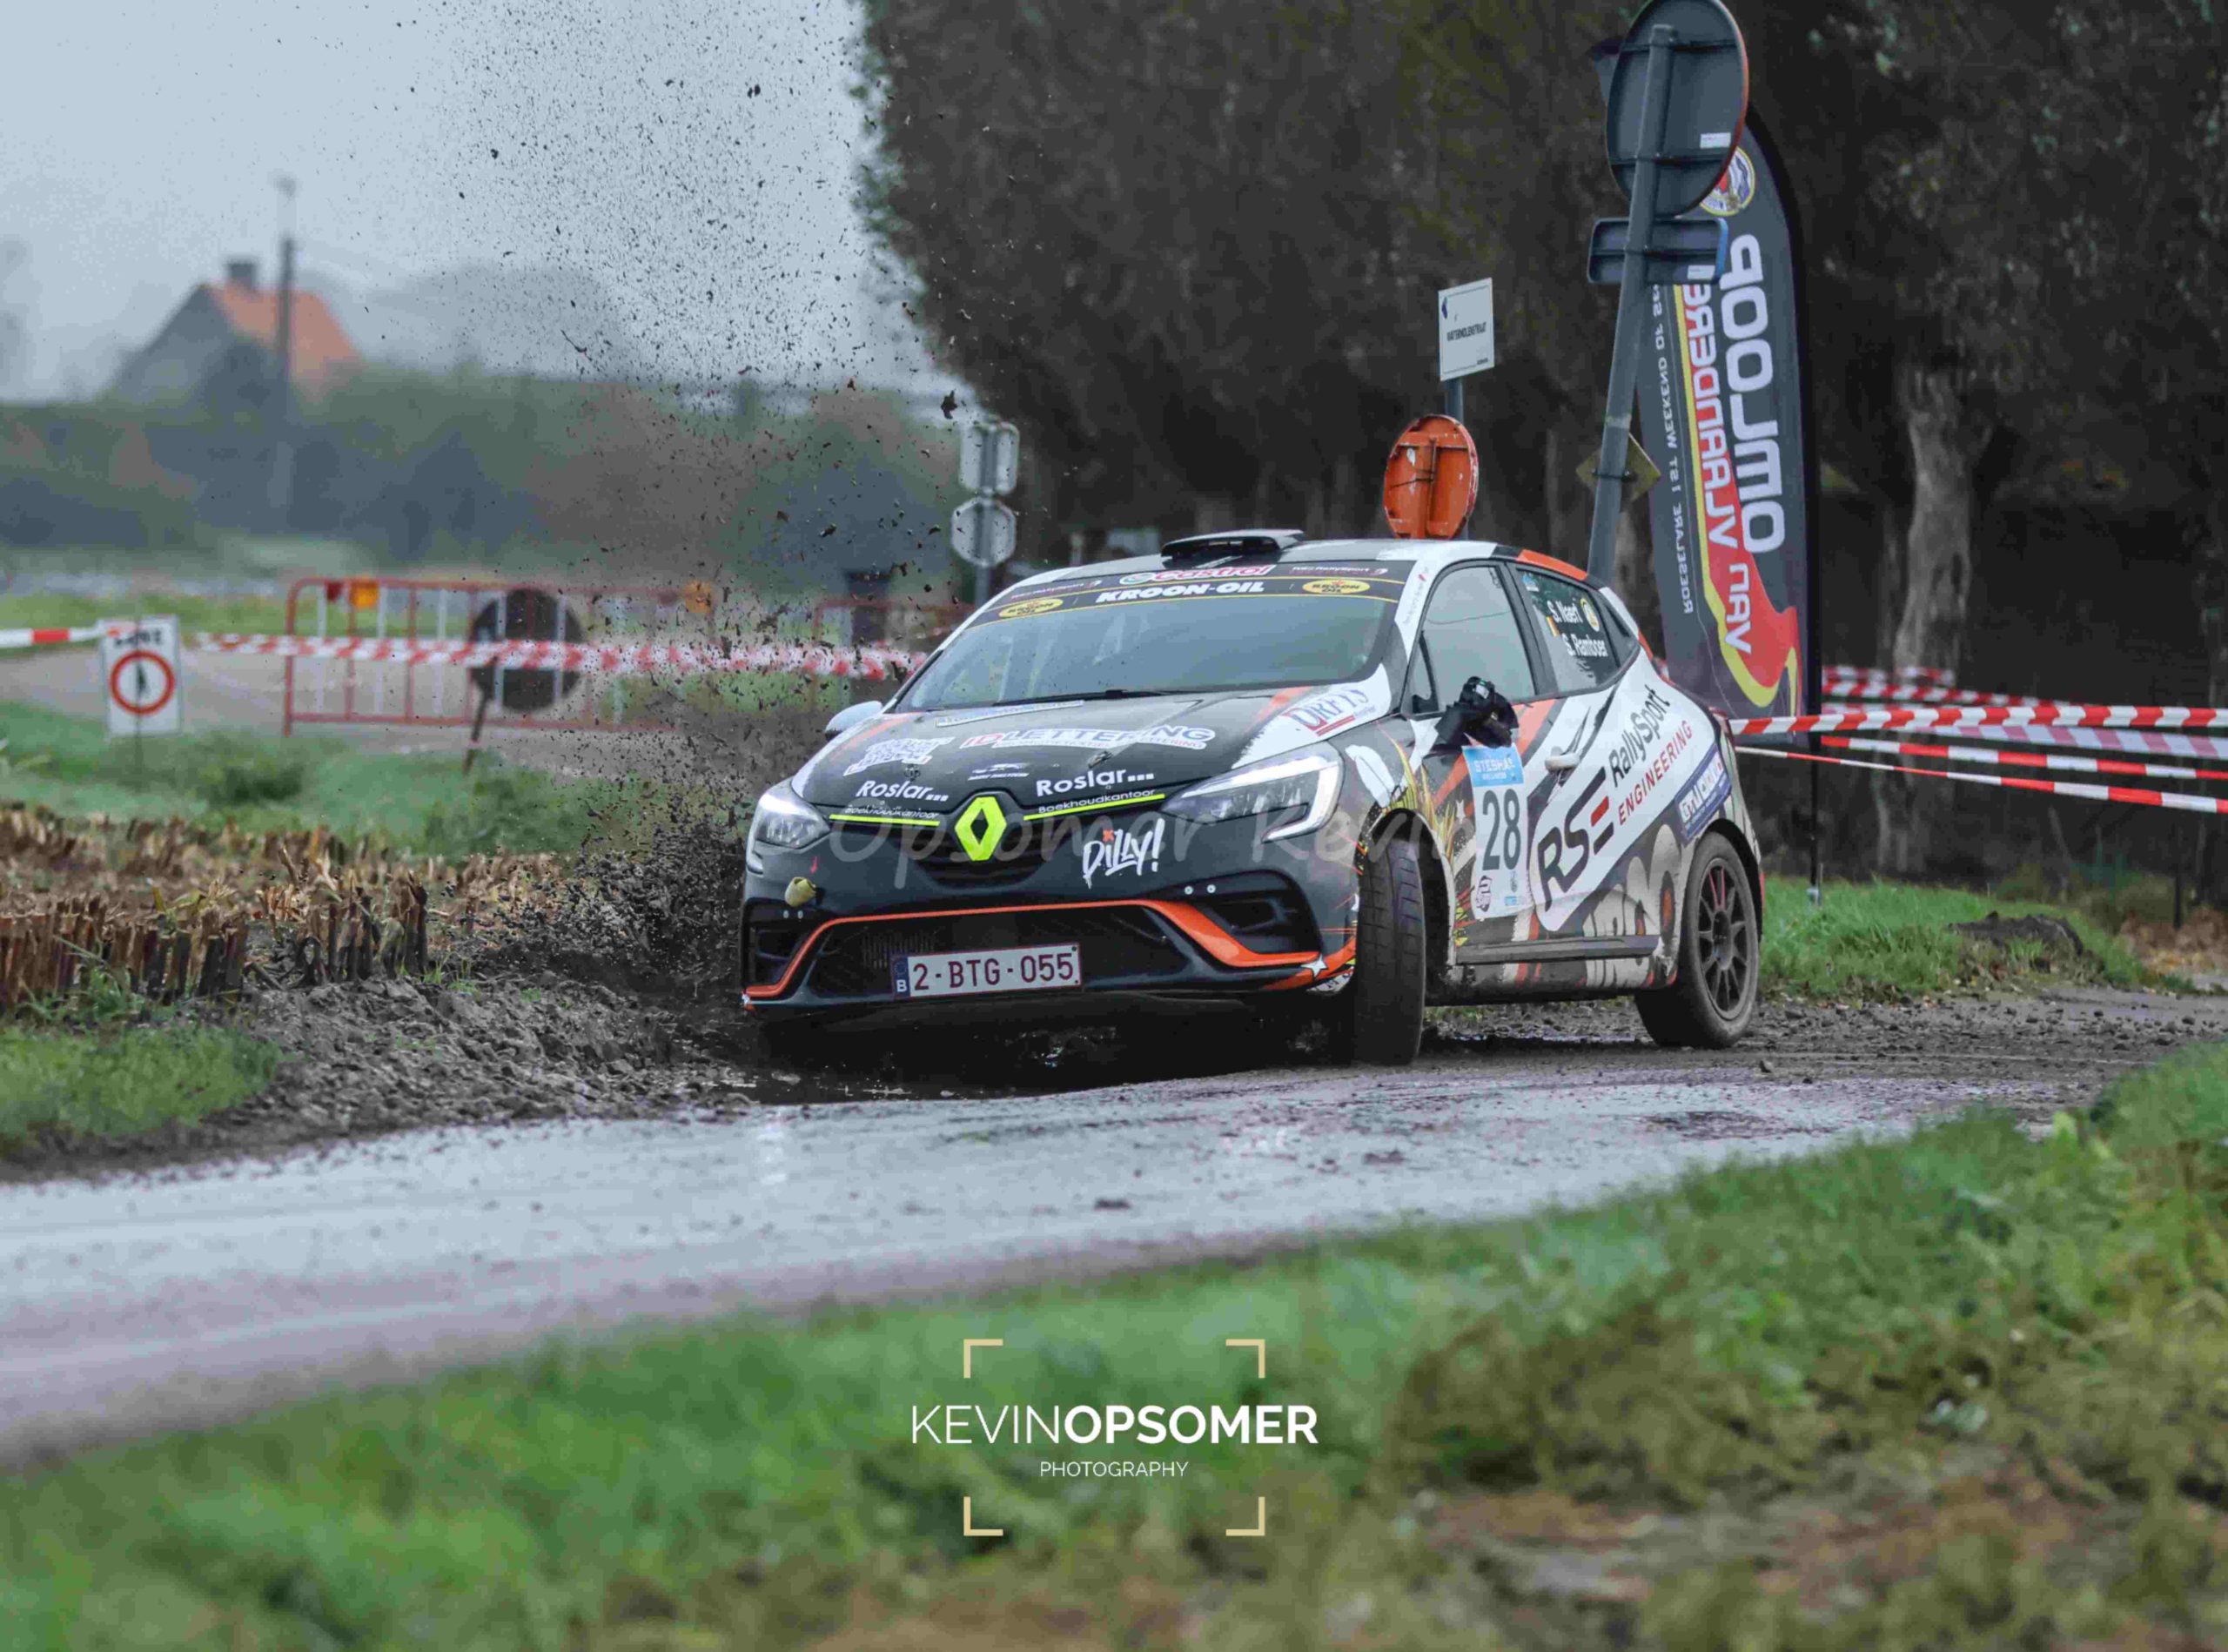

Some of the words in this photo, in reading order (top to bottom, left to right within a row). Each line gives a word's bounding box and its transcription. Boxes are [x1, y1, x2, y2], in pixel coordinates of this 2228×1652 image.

[1153, 564, 1277, 581] Castrol
[1095, 581, 1265, 603] KROON-OIL
[1608, 684, 1670, 787] RallySport
[1618, 719, 1693, 826] ENGINEERING
[1038, 789, 1156, 814] Boekhoudkantoor
[1482, 788, 1521, 870] 28
[896, 979, 908, 993] B
[913, 953, 1074, 991] 2-BTG-055
